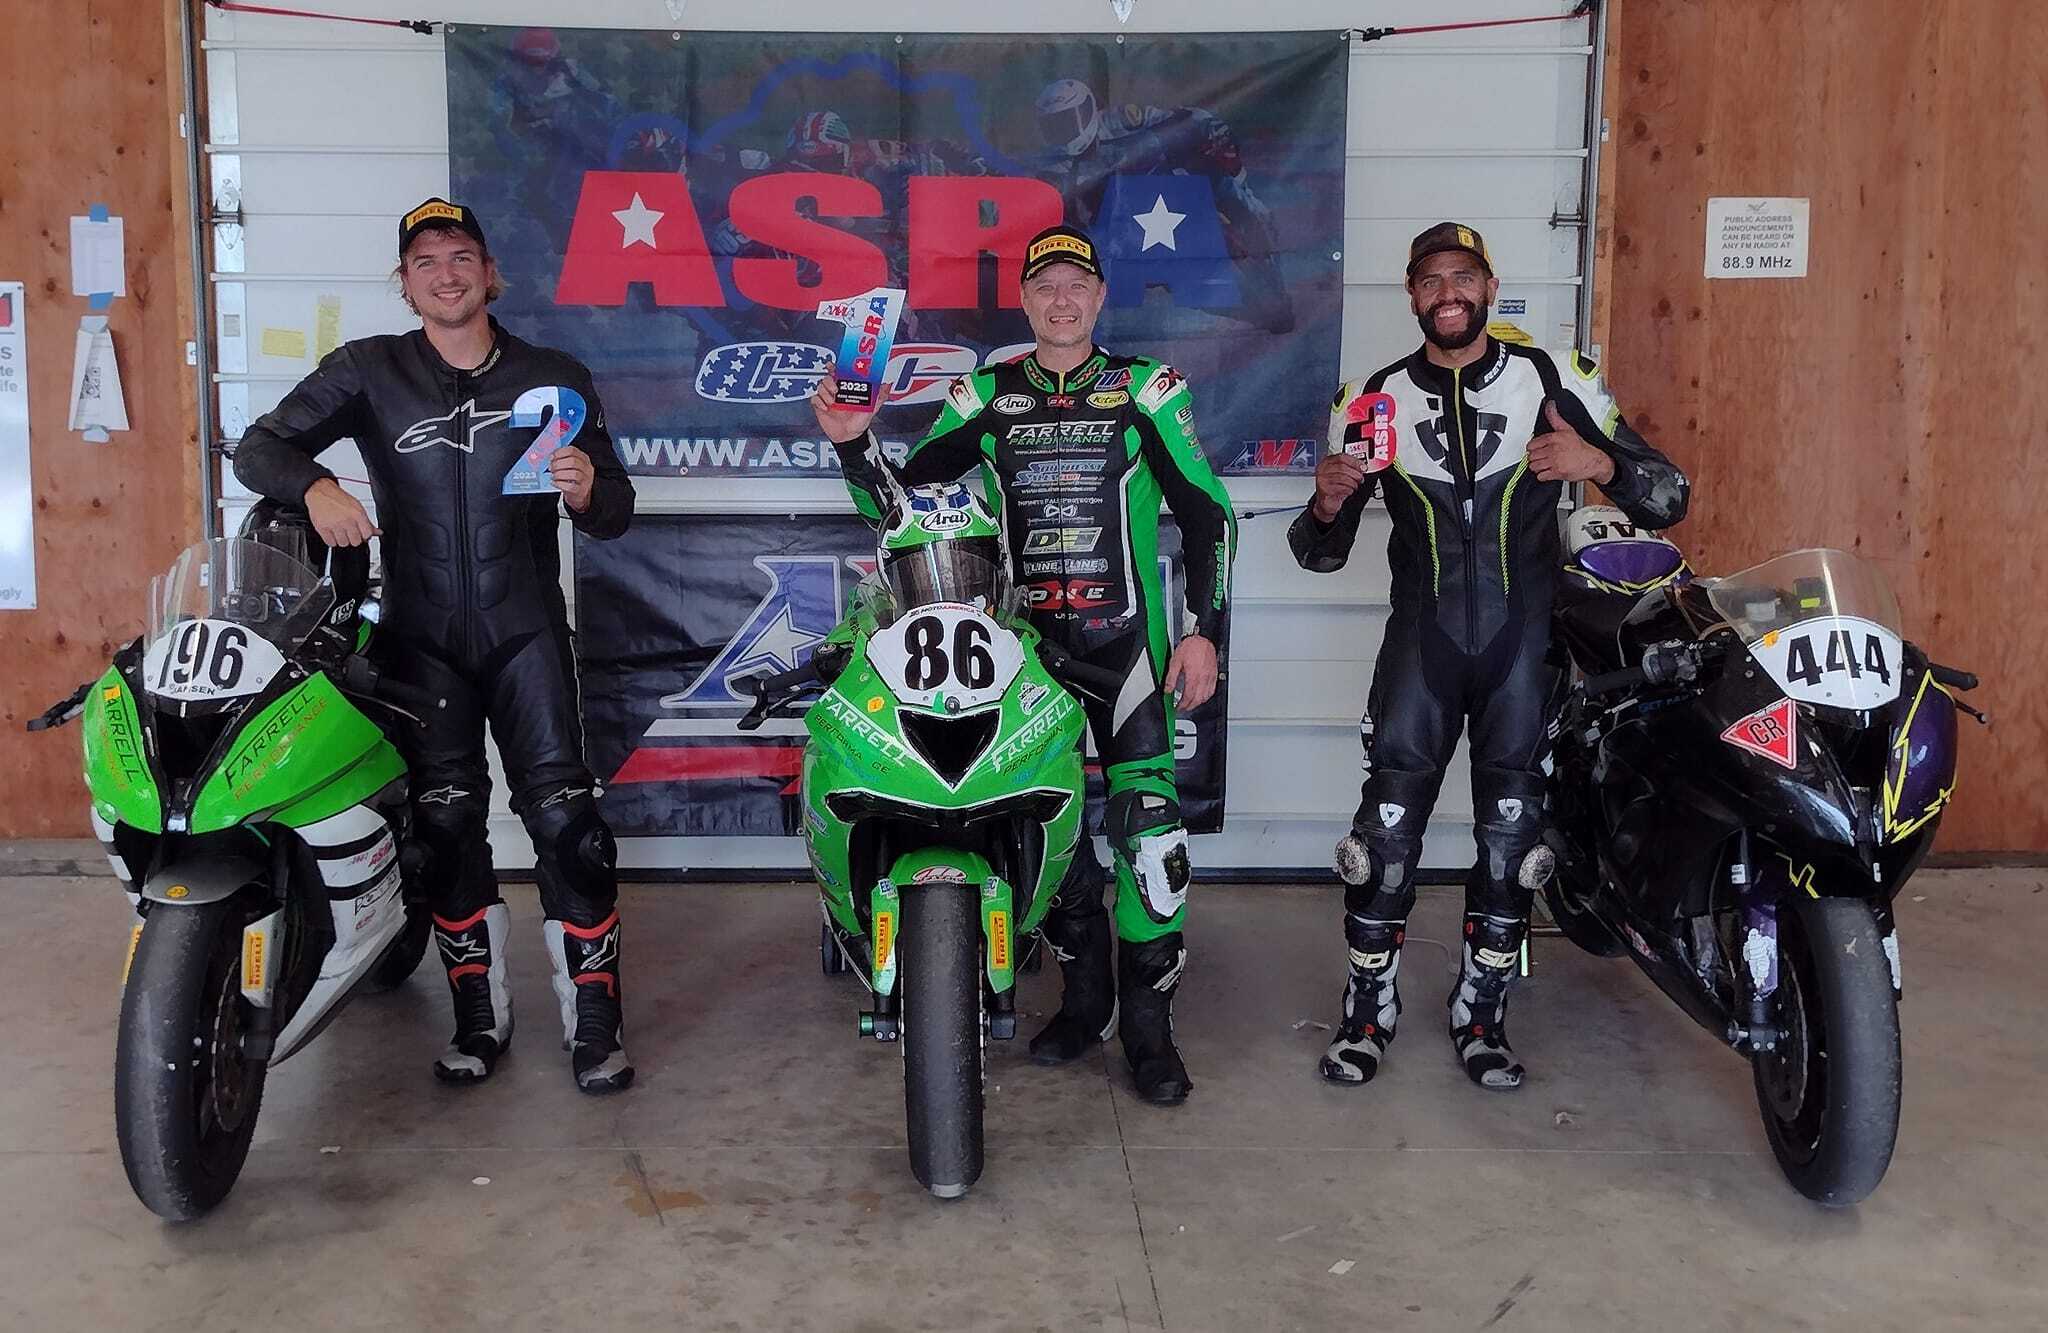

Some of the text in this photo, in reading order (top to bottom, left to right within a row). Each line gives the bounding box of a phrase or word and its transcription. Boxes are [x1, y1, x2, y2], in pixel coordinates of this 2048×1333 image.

[1722, 224, 1794, 232] ANNOUNCEMENTS
[1724, 215, 1793, 223] PUBLIC ADDRESS
[555, 171, 1244, 310] ASRA
[1722, 232, 1794, 241] CAN BE HEARD ON
[1722, 242, 1738, 250] ANY
[1753, 241, 1778, 249] RADIO
[1722, 255, 1792, 269] 88.9 MHz
[840, 381, 868, 392] 2023
[995, 396, 1030, 409] Arai
[1006, 420, 1116, 439] FARRELL
[1222, 439, 1317, 473] AMA
[925, 512, 965, 530] Arai
[904, 616, 995, 690] 86
[1787, 630, 1891, 687] 444
[225, 683, 315, 790] FARRELL
[819, 688, 906, 768] FARRELL
[991, 690, 1074, 773] FARRELL
[1750, 716, 1785, 744] CR
[994, 916, 1006, 965] PIRELLI
[247, 935, 262, 985] PIRELLI
